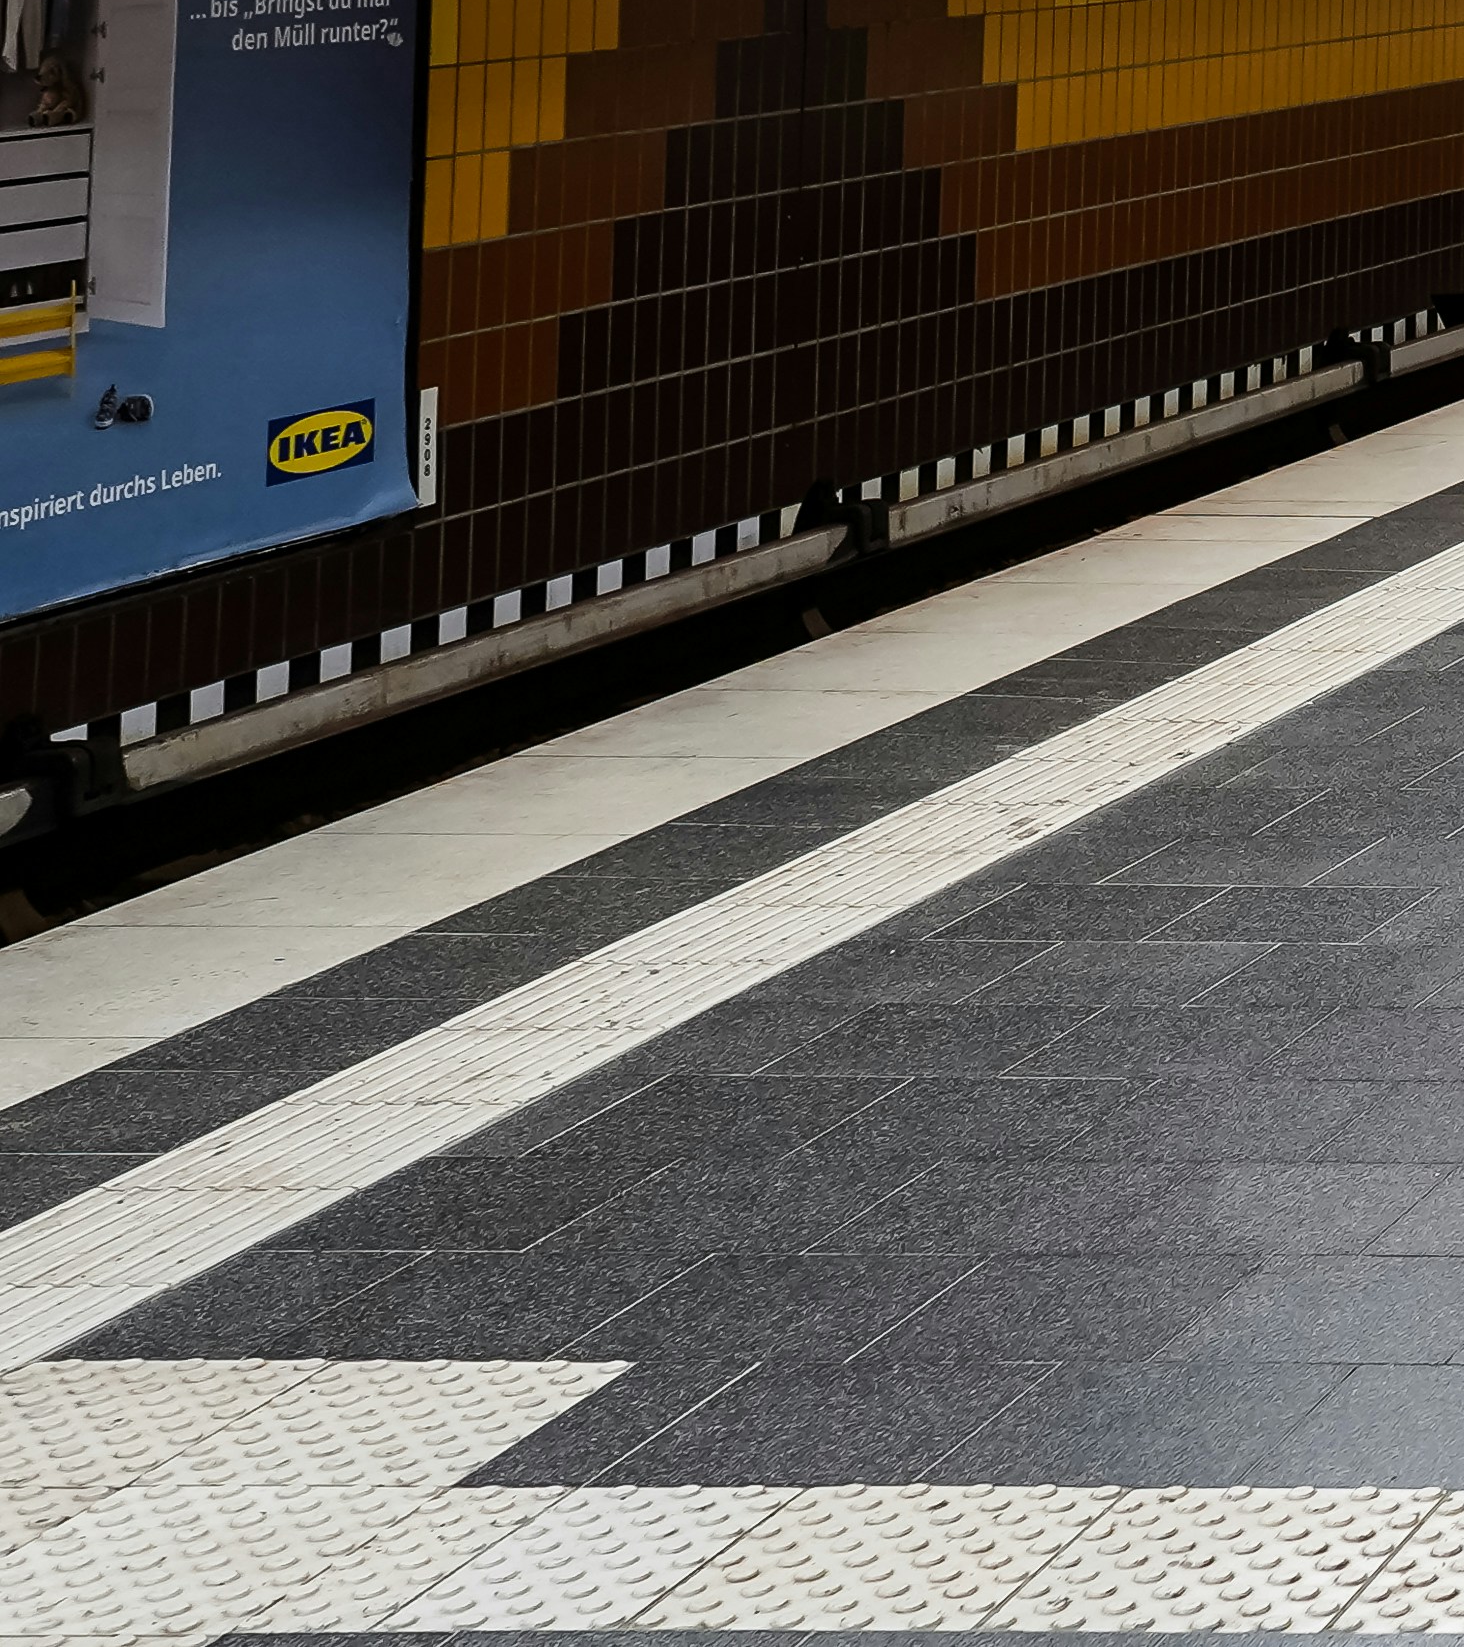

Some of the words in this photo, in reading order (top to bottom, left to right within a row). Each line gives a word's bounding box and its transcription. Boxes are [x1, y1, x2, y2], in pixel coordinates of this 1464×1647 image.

[231, 28, 269, 52] den
[273, 22, 316, 48] Müll
[277, 420, 367, 464] IKEA
[88, 474, 157, 508] durchs
[160, 462, 223, 491] Leben.
